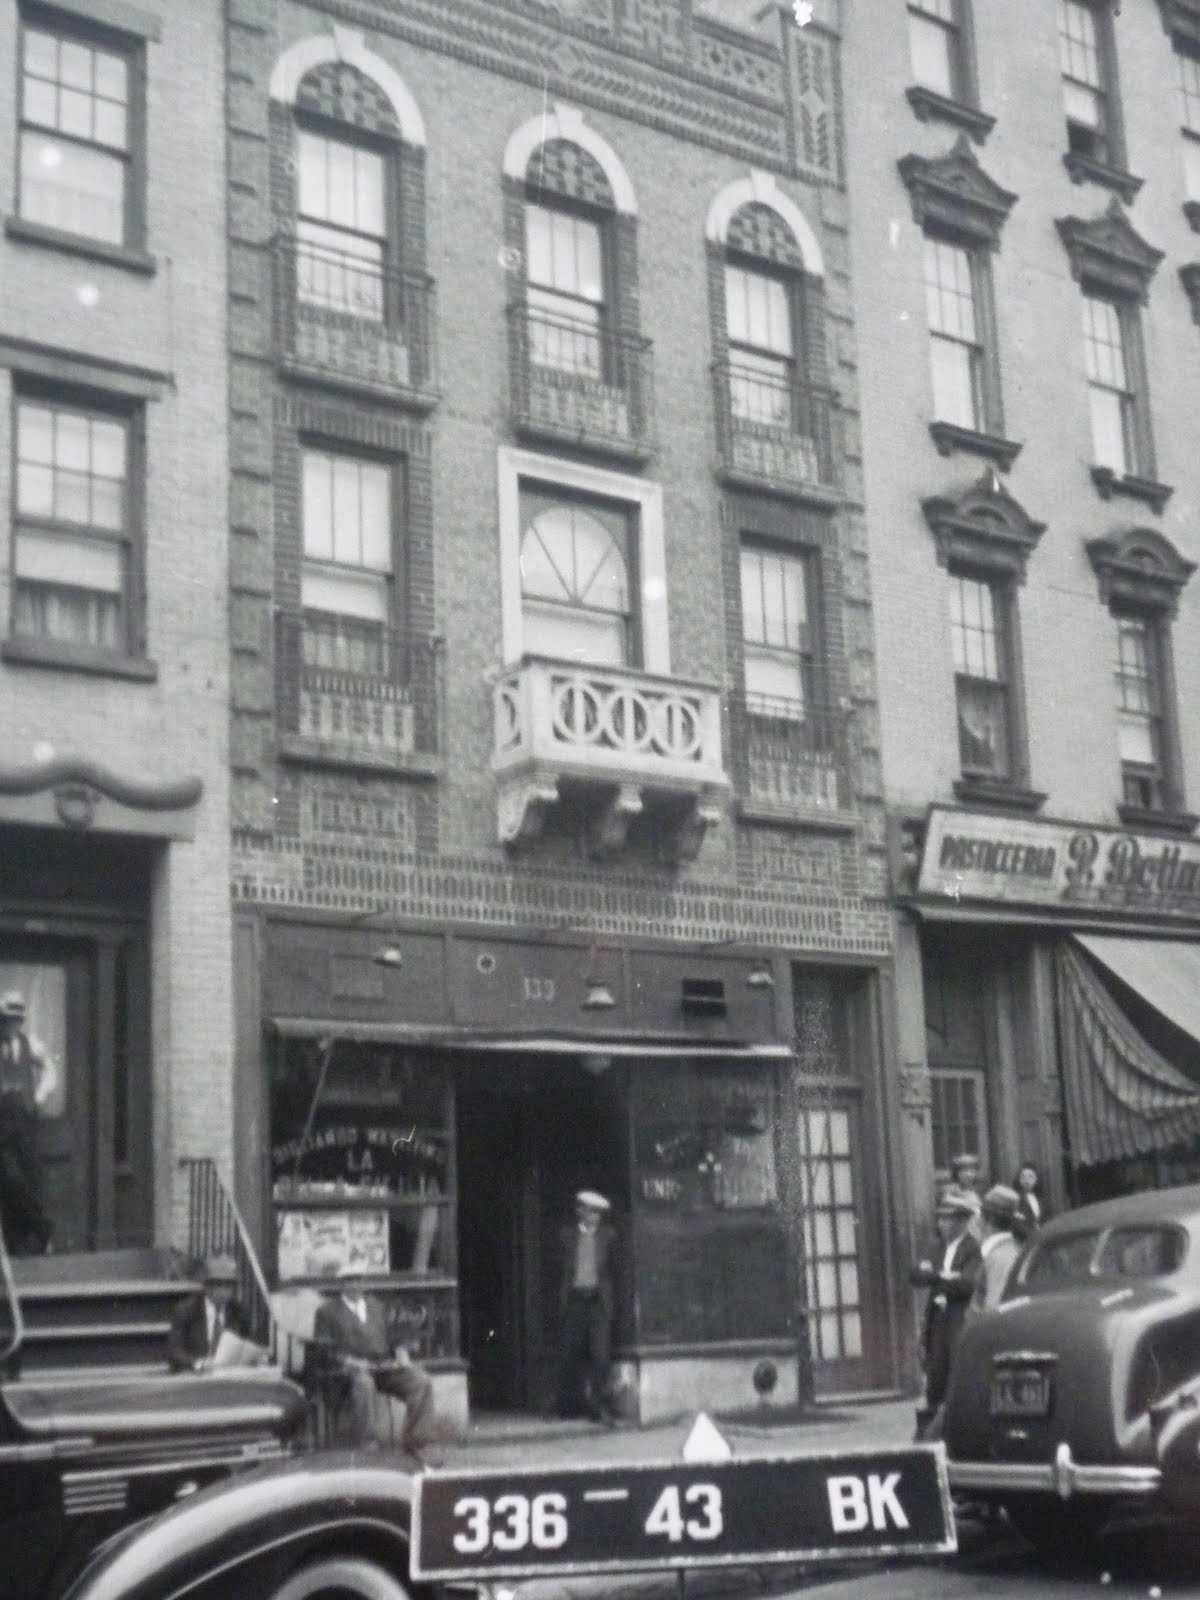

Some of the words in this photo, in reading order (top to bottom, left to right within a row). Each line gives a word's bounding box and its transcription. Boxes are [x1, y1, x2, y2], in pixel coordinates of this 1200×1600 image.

[453, 1492, 568, 1555] 336
[645, 1483, 724, 1542] 43
[826, 1473, 910, 1534] BK
